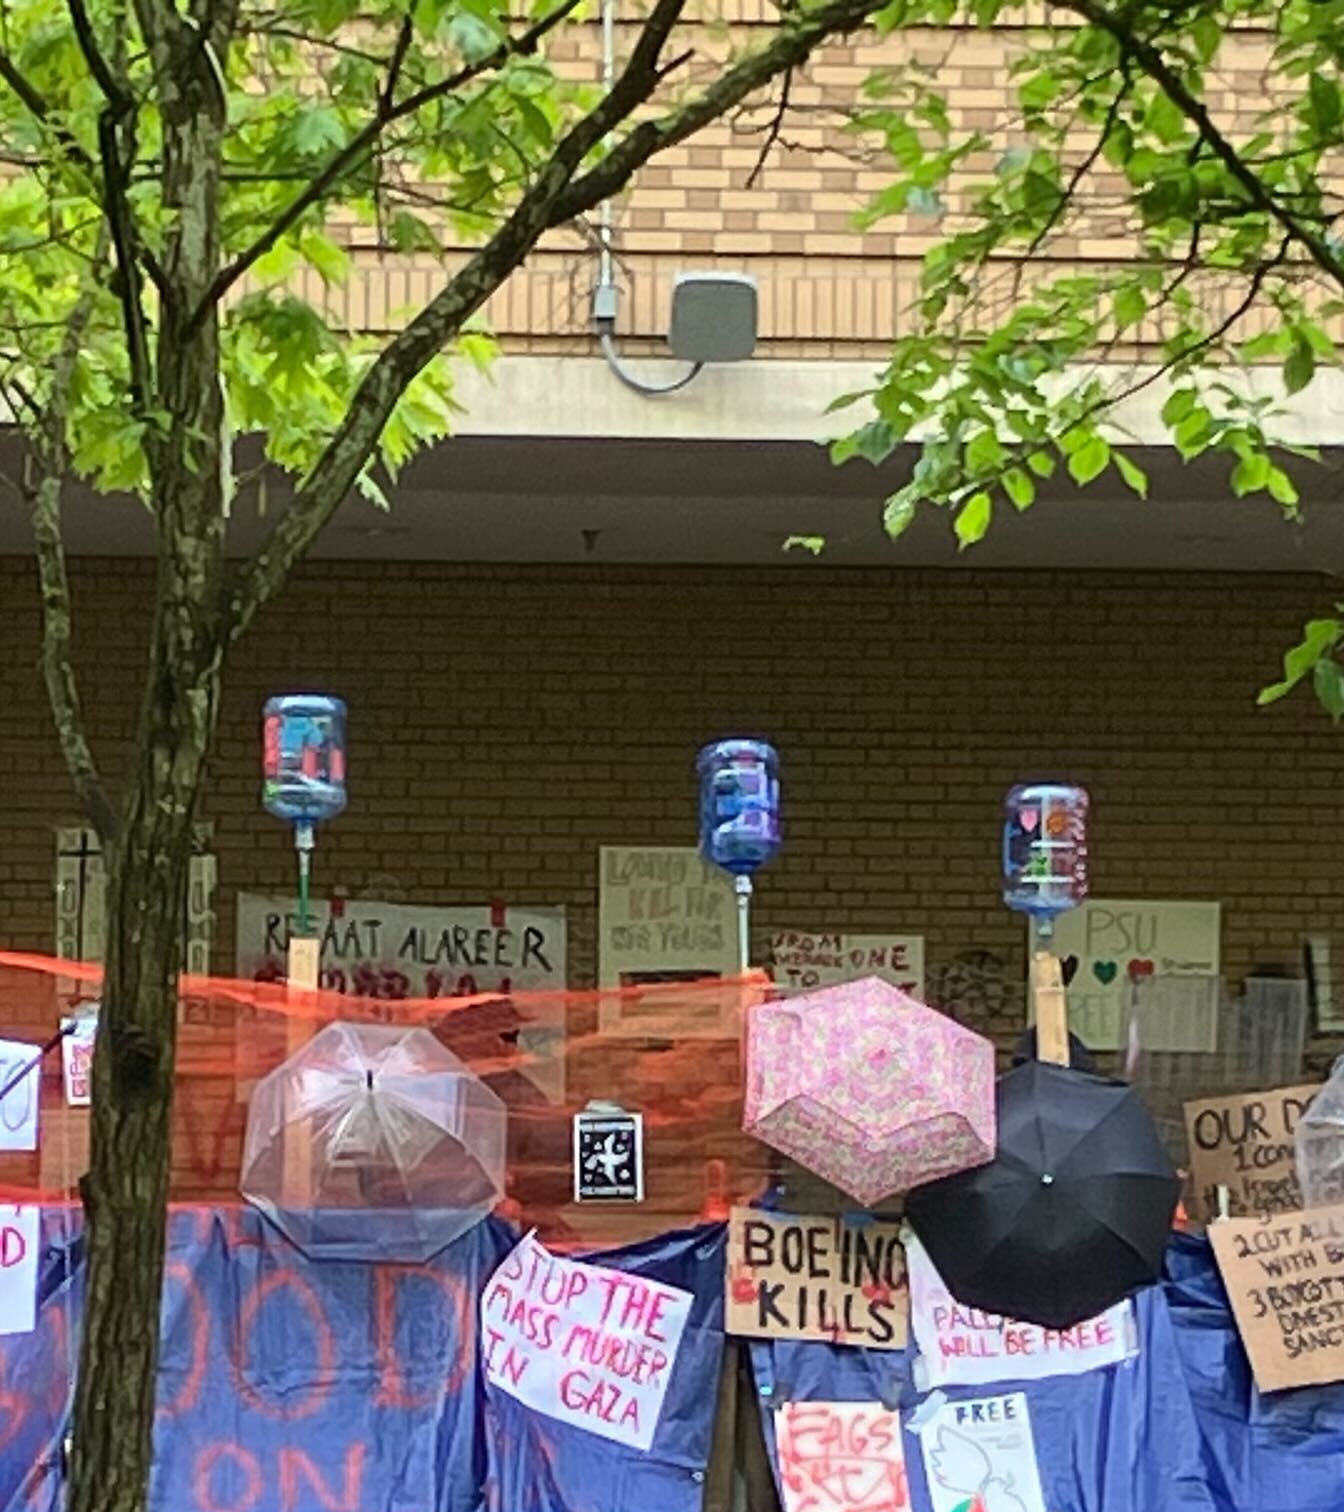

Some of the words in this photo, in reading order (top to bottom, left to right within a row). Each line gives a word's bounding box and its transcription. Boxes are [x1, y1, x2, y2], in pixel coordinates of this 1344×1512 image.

[399, 924, 553, 973] ALAREER
[1086, 908, 1156, 957] PSU
[1194, 1102, 1273, 1150] OUR
[1257, 1248, 1317, 1278] WITH
[599, 1275, 679, 1343] THE
[758, 1280, 895, 1342] KILLS
[1245, 1288, 1267, 1318] 3
[486, 1283, 560, 1350] MASS
[562, 1324, 668, 1389] MURDER
[938, 1332, 999, 1358] WILL
[1005, 1327, 1037, 1356] BE
[1044, 1322, 1115, 1352] FREE
[484, 1326, 530, 1389] IN
[559, 1369, 641, 1434] GAZA
[956, 1399, 1016, 1425] FREE
